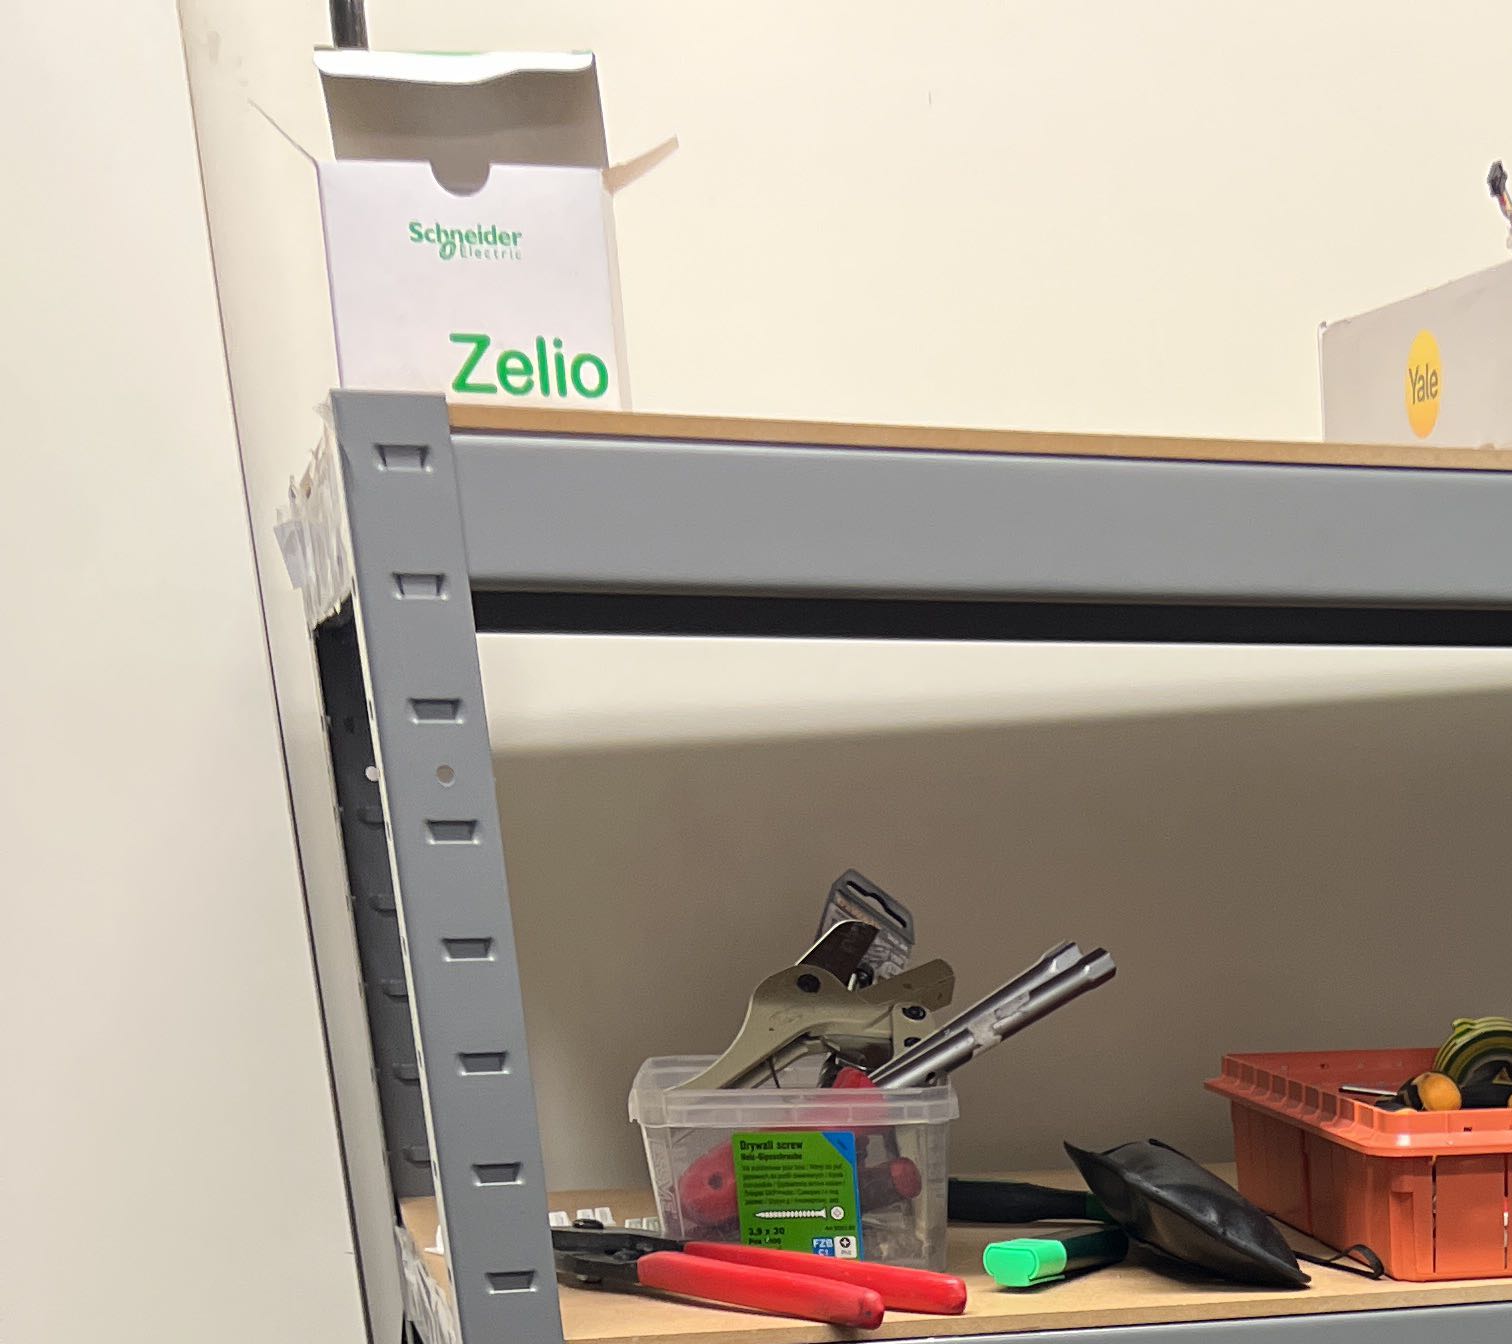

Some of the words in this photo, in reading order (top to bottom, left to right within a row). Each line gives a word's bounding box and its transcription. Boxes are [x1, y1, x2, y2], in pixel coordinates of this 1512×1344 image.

[408, 221, 523, 248] Schneider
[449, 333, 609, 399] Zelio
[1408, 362, 1439, 405] Yale
[739, 1140, 774, 1152] Drywall
[776, 1141, 804, 1150] screw
